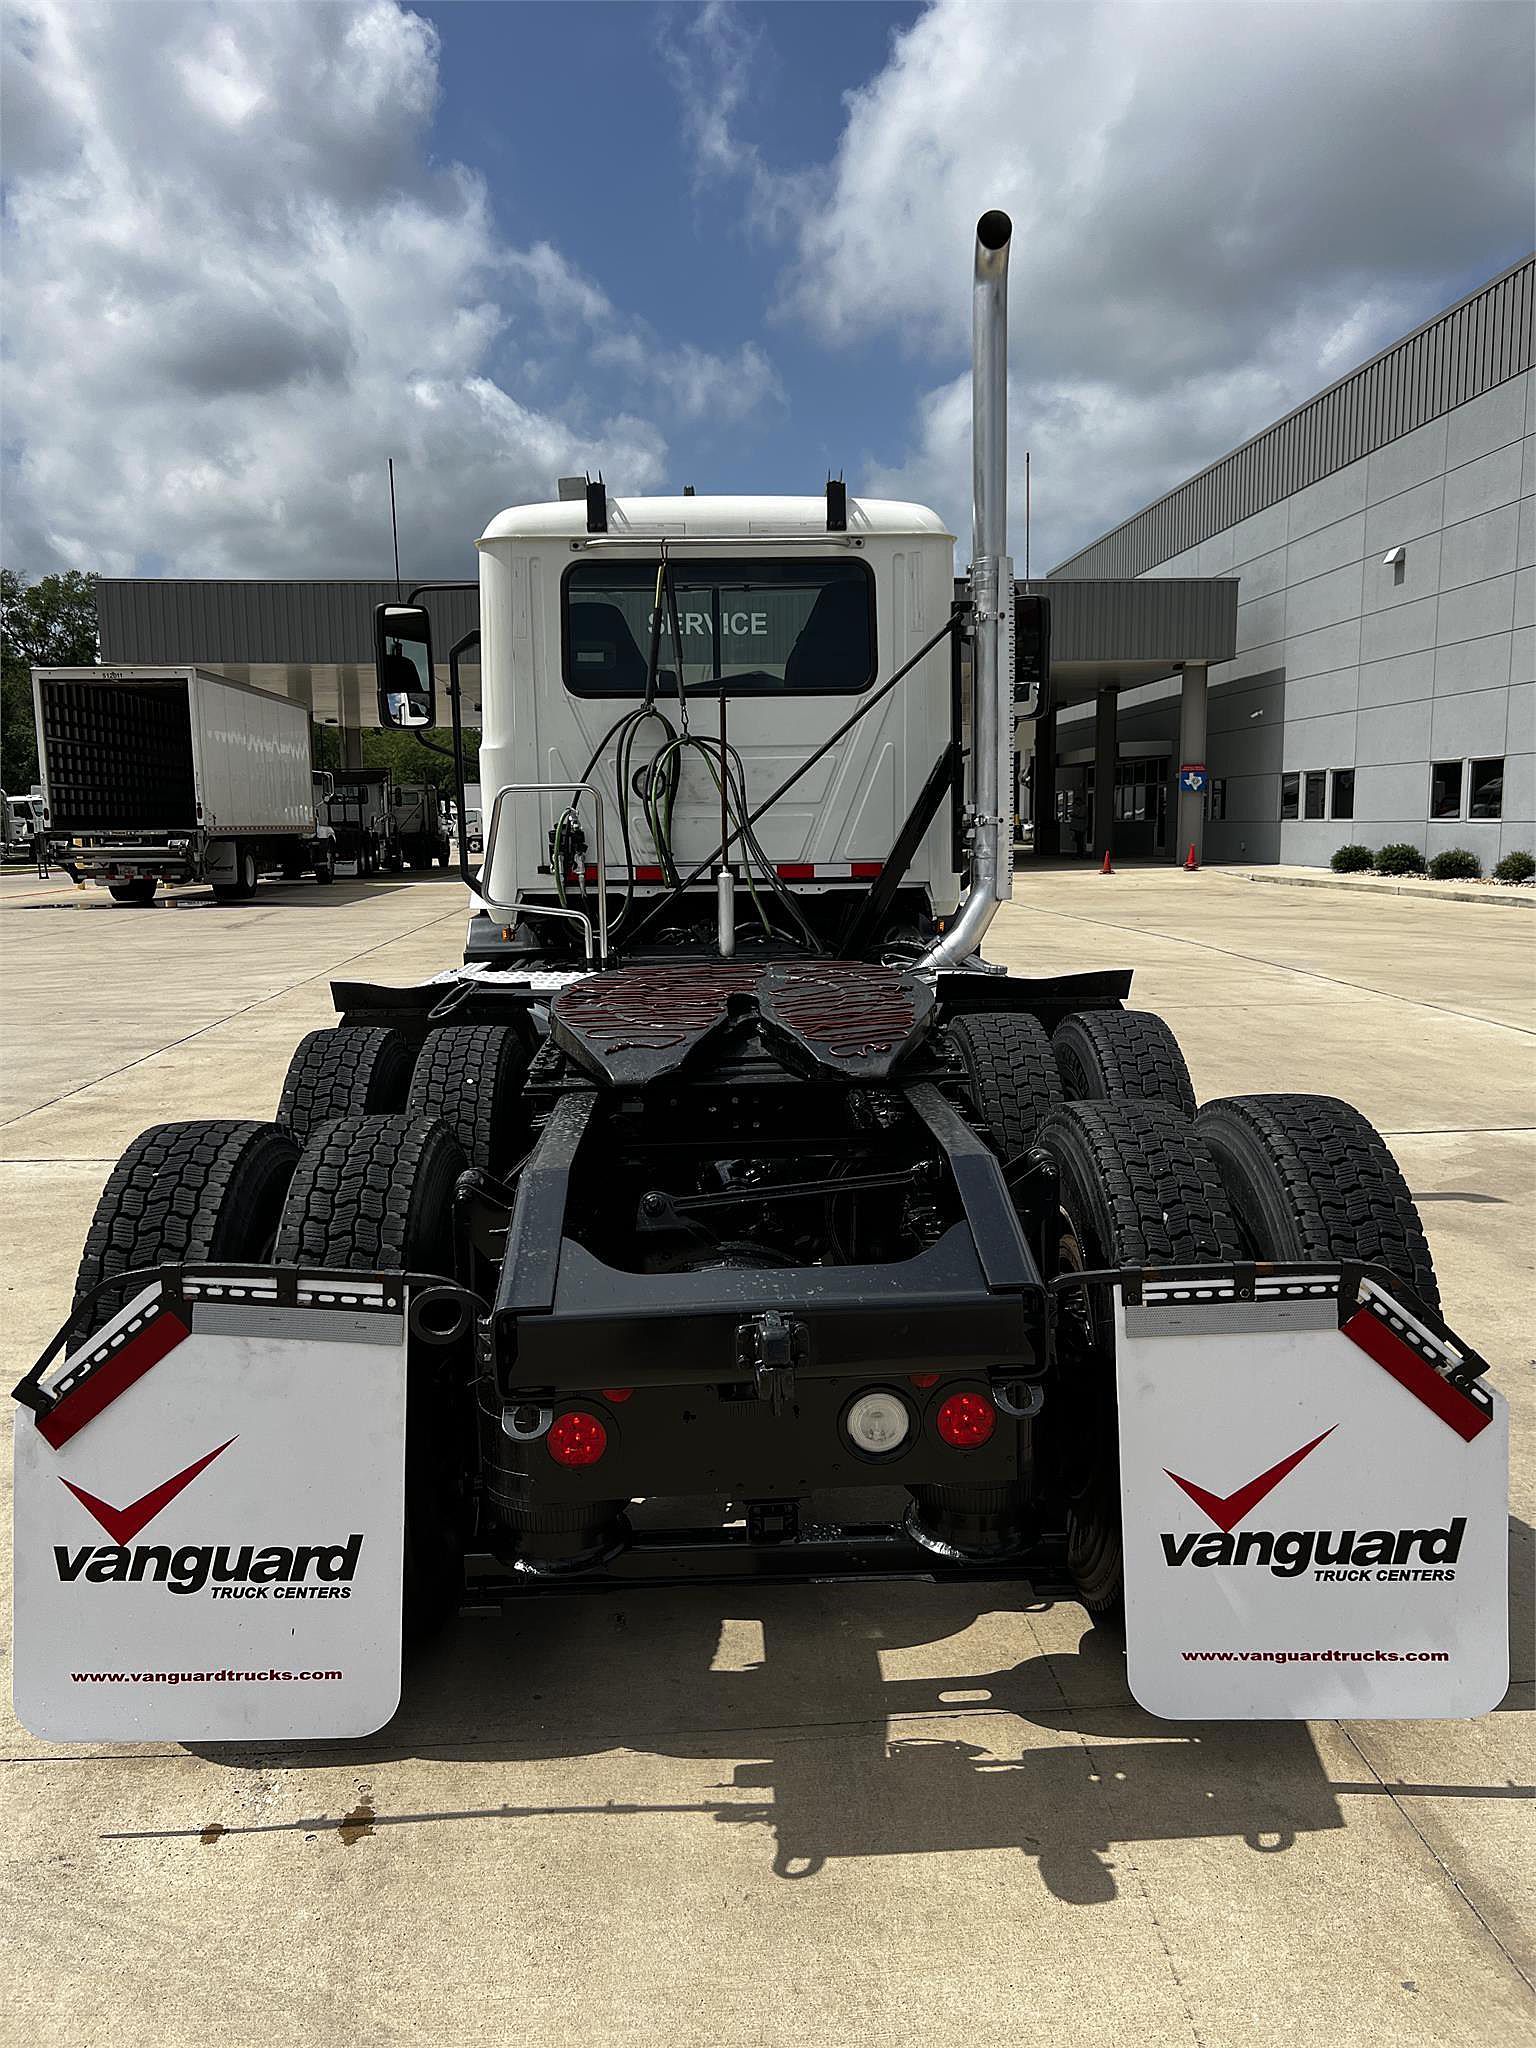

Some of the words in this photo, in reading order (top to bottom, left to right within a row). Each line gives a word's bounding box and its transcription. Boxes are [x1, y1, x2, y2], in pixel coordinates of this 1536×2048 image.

[647, 612, 768, 635] SERVICE
[1159, 1517, 1468, 1578] vanguard
[53, 1533, 364, 1595] vanguard
[1314, 1570, 1372, 1582] TRUCK
[1376, 1569, 1456, 1582] CENTERS
[211, 1586, 268, 1599] TRUCK
[273, 1586, 352, 1599] CENTERS
[1181, 1651, 1450, 1664] www.vanguardtrucks.com
[70, 1670, 344, 1685] www.vanguardtrucks.com
